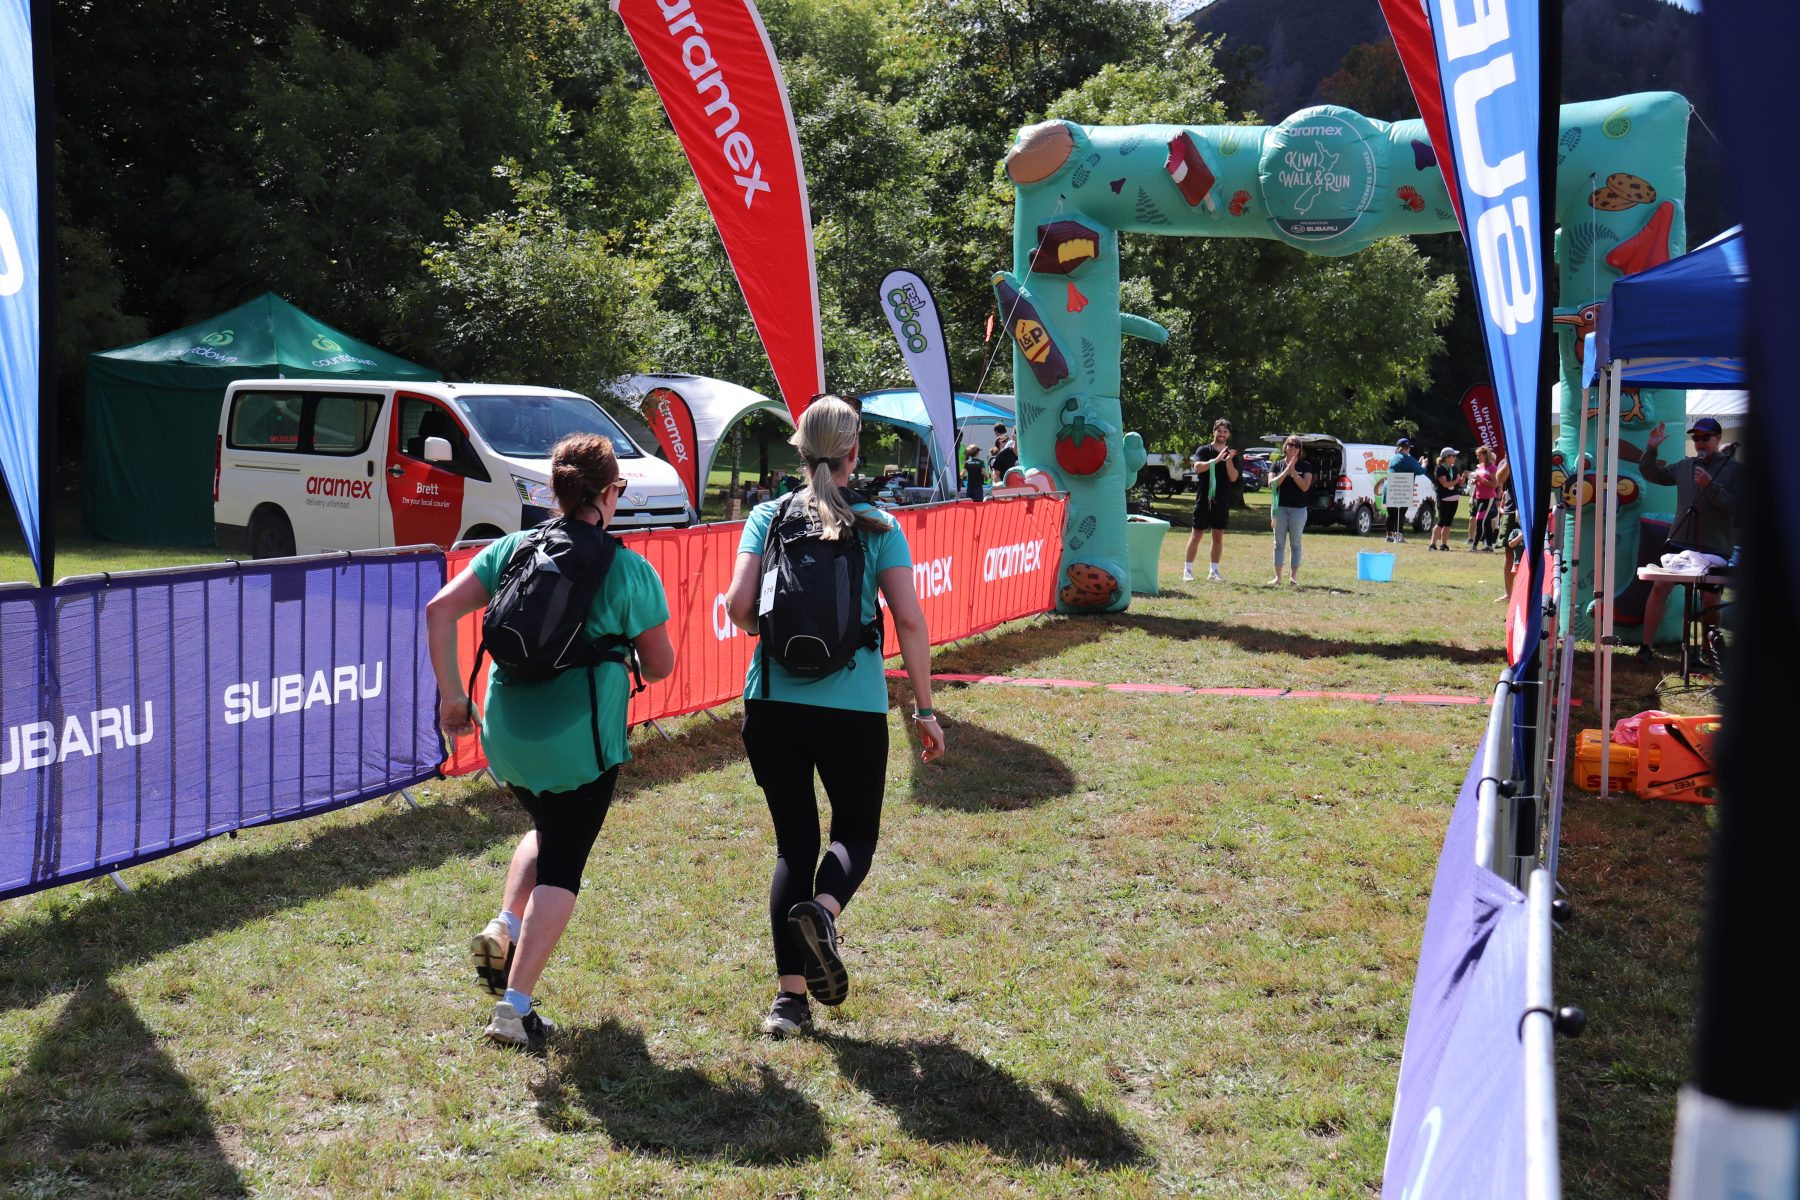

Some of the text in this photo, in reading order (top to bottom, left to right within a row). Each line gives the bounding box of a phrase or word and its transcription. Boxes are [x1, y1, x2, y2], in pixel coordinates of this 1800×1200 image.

[1288, 125, 1344, 137] aramex
[1284, 151, 1318, 172] KIWI
[1279, 170, 1350, 192] WALK & RUN
[902, 283, 926, 311] real
[312, 353, 378, 367] countdown
[1470, 398, 1494, 452] YOUR POW
[1481, 406, 1498, 448] UNLEASH
[306, 475, 374, 499] aramex
[416, 482, 439, 495] Brett
[410, 499, 420, 507] your
[421, 499, 433, 507] local
[984, 540, 1042, 583] aramex
[911, 556, 953, 600] mex
[223, 661, 383, 725] SUBARU
[1587, 774, 1633, 790] SET
